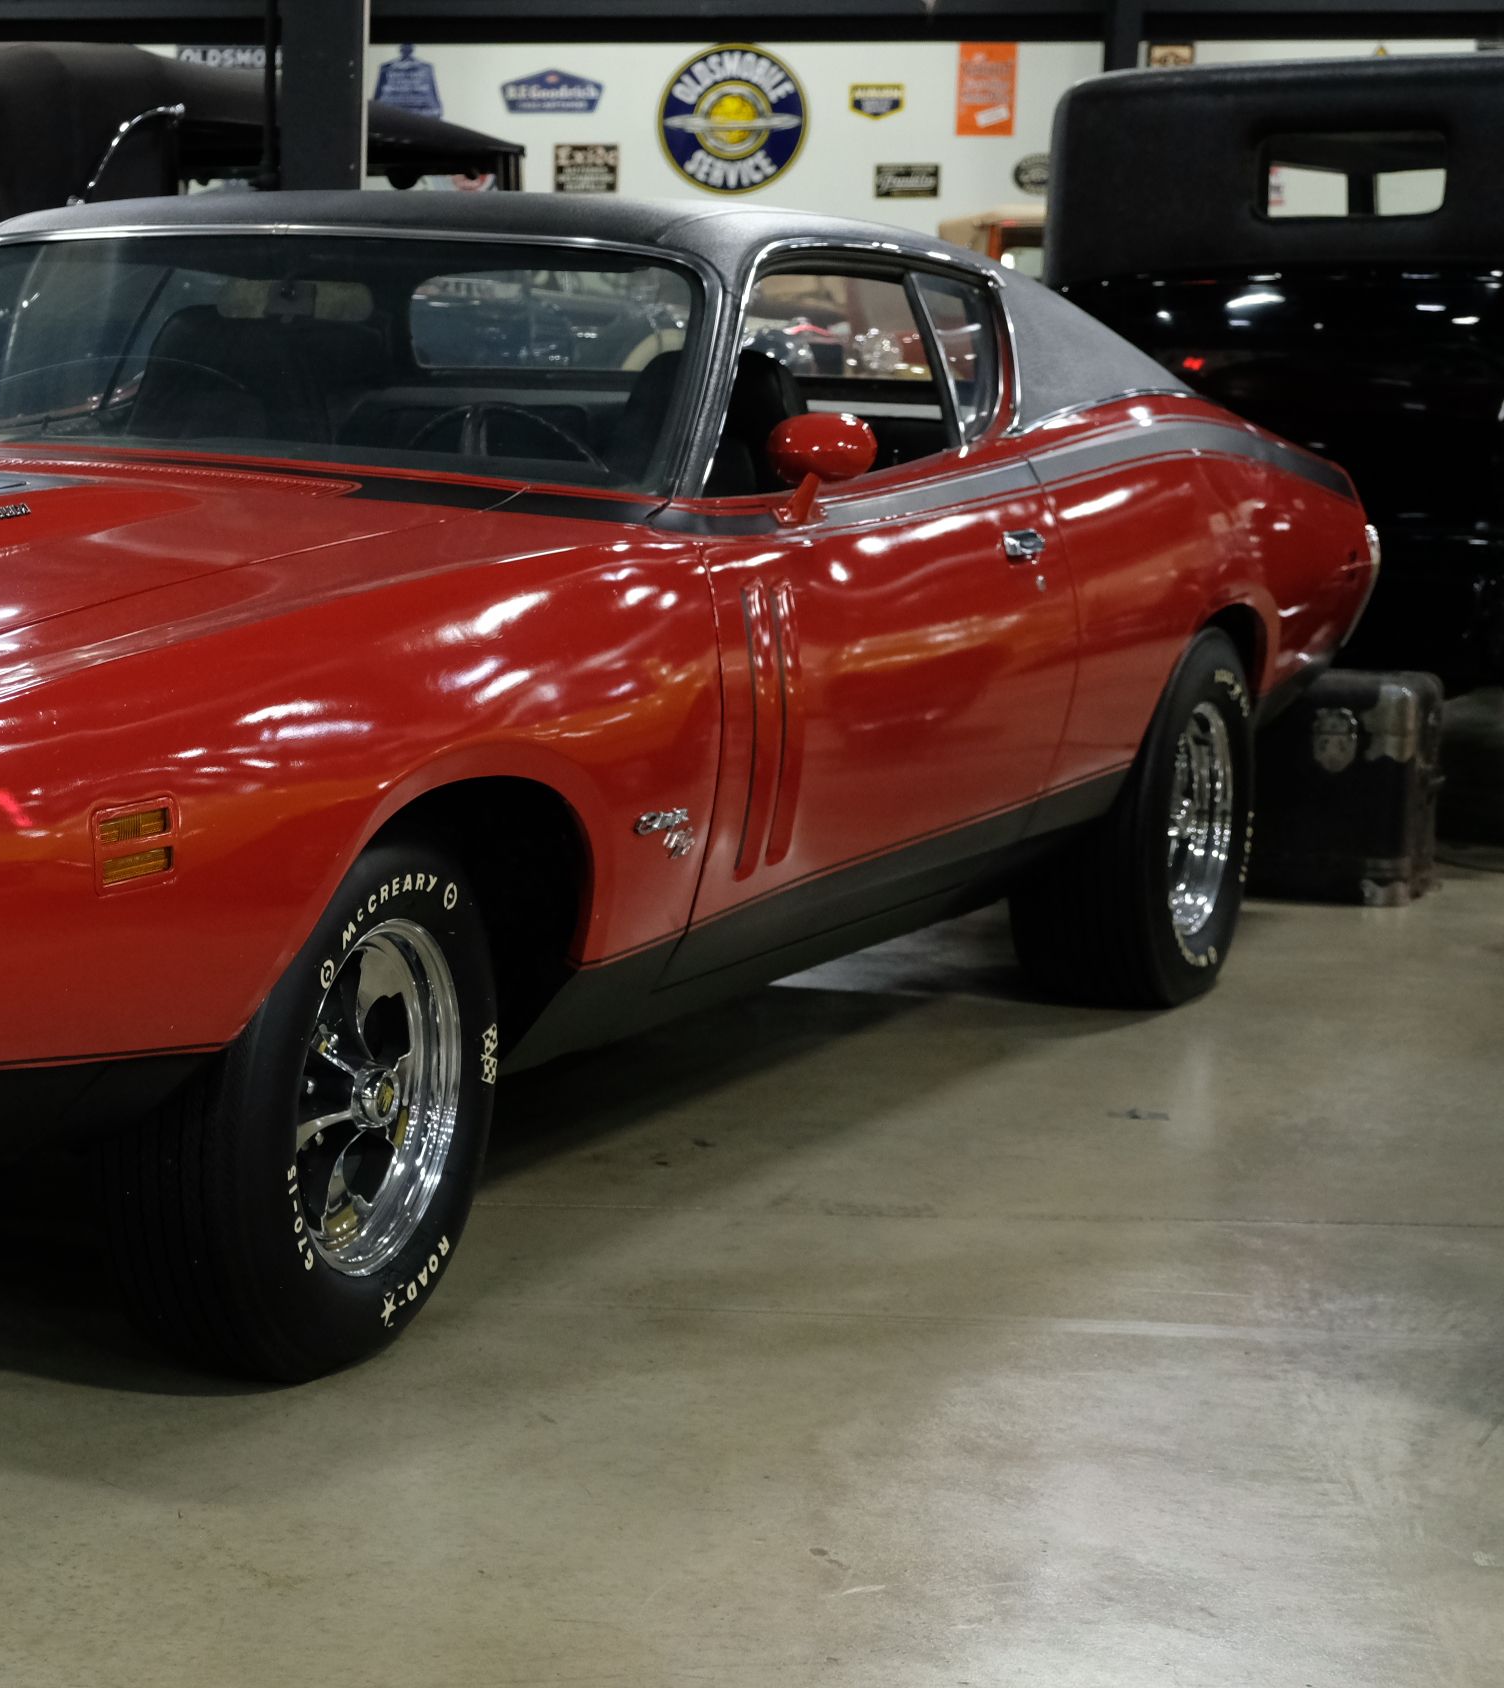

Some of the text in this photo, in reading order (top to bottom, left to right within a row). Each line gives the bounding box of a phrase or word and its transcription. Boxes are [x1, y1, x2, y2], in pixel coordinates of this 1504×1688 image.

[179, 47, 283, 68] OLDSMO
[671, 50, 796, 105] OLDSMOBILE
[683, 149, 778, 189] SERVICE
[342, 872, 438, 951] McCREARY
